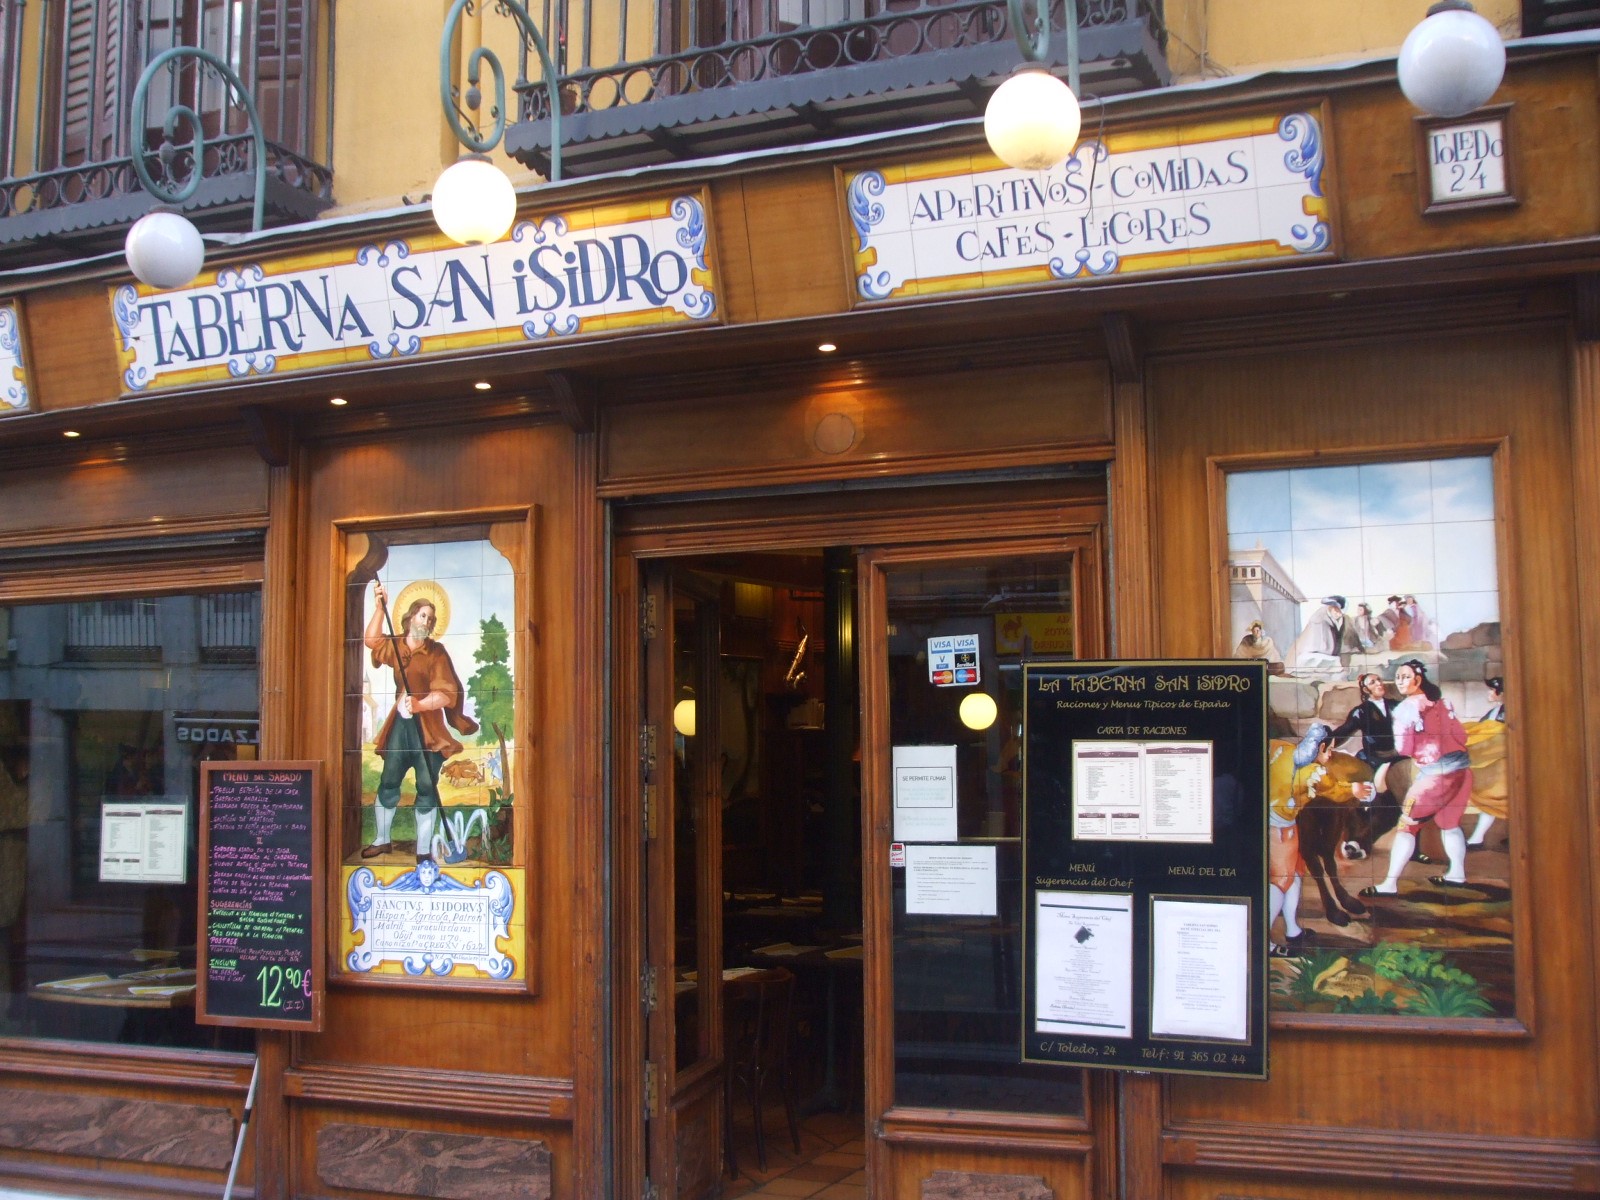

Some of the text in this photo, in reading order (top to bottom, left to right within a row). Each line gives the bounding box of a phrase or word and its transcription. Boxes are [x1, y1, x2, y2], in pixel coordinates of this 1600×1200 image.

[1110, 150, 1249, 199] COMIDAS
[1450, 160, 1487, 192] 24
[956, 201, 1212, 263] CAFÉS LICORES
[138, 274, 374, 367] TABERNA
[390, 254, 497, 331] SAN
[1039, 677, 1060, 692] LA
[1067, 675, 1146, 692] TABERNA
[1154, 675, 1189, 692] SAN
[1057, 700, 1100, 708] Raciones
[1102, 702, 1107, 710] y
[1194, 700, 1231, 710] España
[1097, 726, 1188, 735] CARTA DE RACIONES
[223, 773, 248, 782] MENU
[1069, 863, 1096, 873] MENÚ
[1168, 866, 1195, 876] MENÚ
[1199, 868, 1216, 876] DEL
[1035, 876, 1134, 888] Sugerencia del Chef
[210, 900, 252, 909] SUGERENCIAS
[431, 902, 484, 912] ISIDORVS
[210, 937, 238, 945] POSTRES
[1040, 1042, 1054, 1051] C/
[1103, 1046, 1117, 1055] 24
[1173, 1051, 1185, 1060] 91
[1190, 1052, 1209, 1062] 365
[1213, 1053, 1227, 1063] 02
[1231, 1054, 1246, 1064] 44
